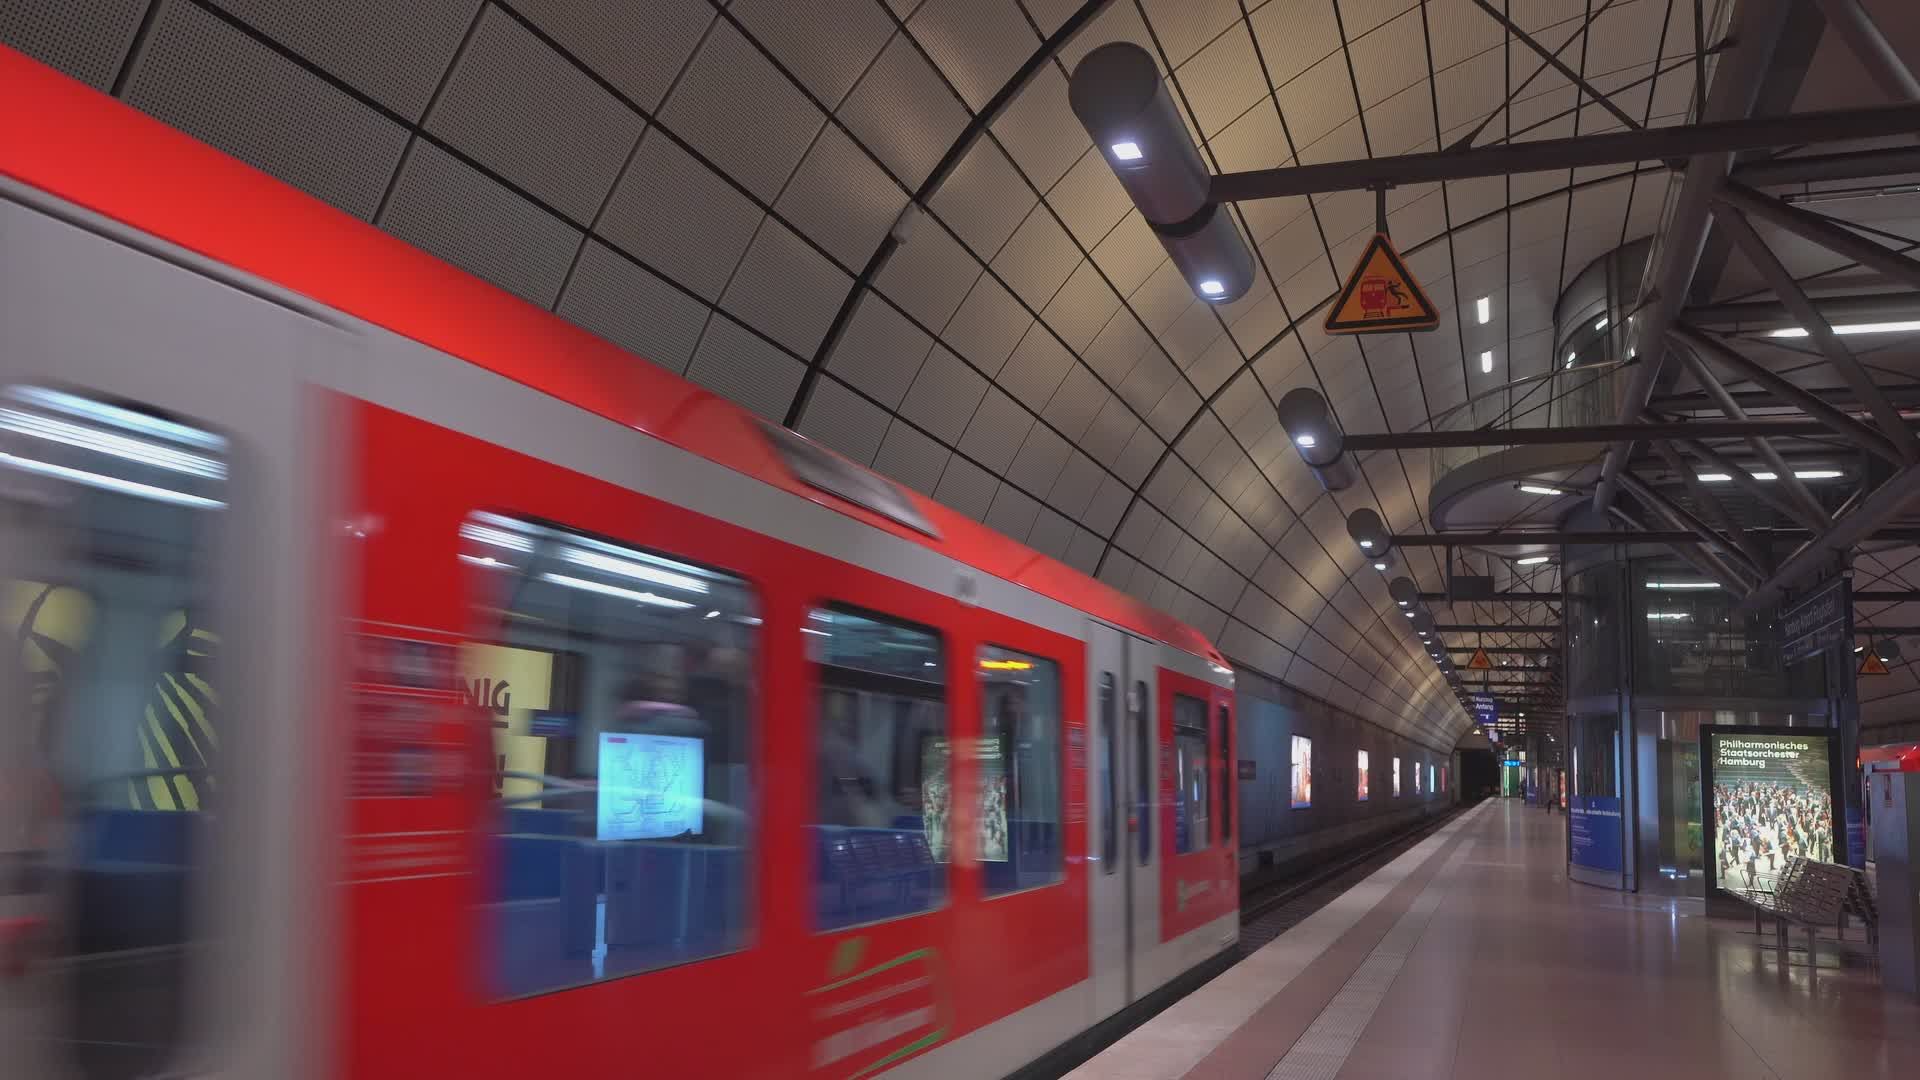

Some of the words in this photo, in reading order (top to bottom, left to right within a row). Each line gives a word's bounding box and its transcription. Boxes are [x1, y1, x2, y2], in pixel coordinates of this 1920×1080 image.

[1719, 740, 1809, 750] Philharmonisches
[1720, 749, 1800, 758] Staatsorchester
[1720, 758, 1766, 769] Hamburg
